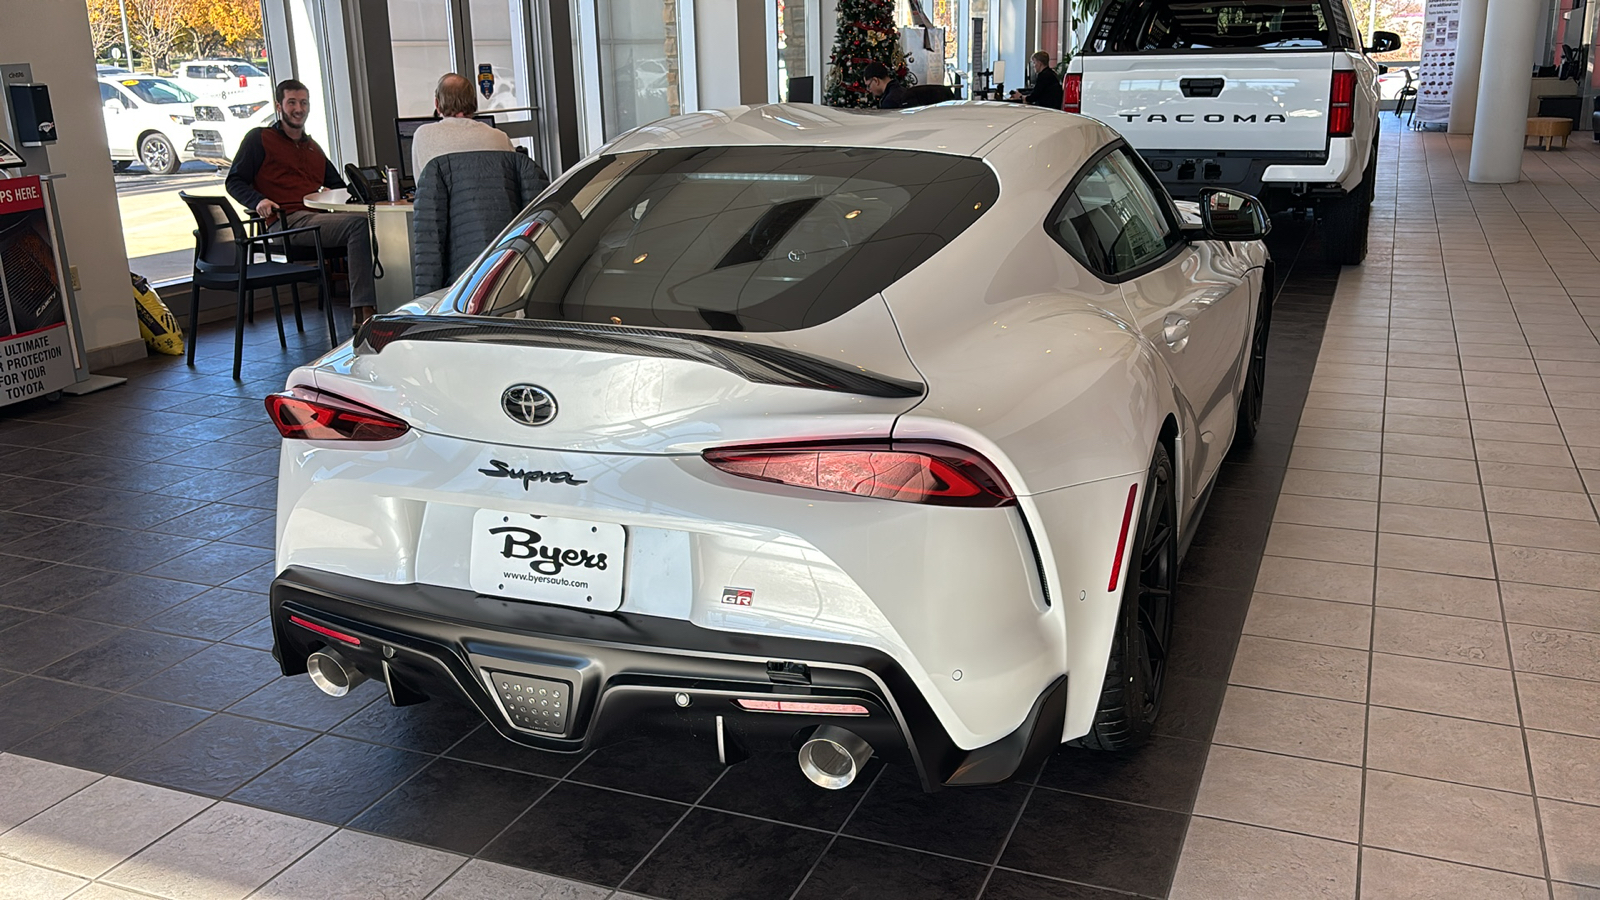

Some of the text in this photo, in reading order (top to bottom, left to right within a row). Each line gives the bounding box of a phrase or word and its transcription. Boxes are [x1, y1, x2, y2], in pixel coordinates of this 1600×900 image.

[1119, 114, 1286, 123] TACOMA
[14, 186, 40, 201] HERE.
[4, 335, 50, 357] ULTIMATE
[7, 346, 62, 371] PROTECTION
[21, 365, 47, 382] YOUR
[6, 380, 45, 400] TOYOTA
[477, 459, 588, 491] Supra
[488, 526, 608, 576] Byers
[503, 571, 589, 589] www.byersauto.com
[722, 594, 751, 606] GR
